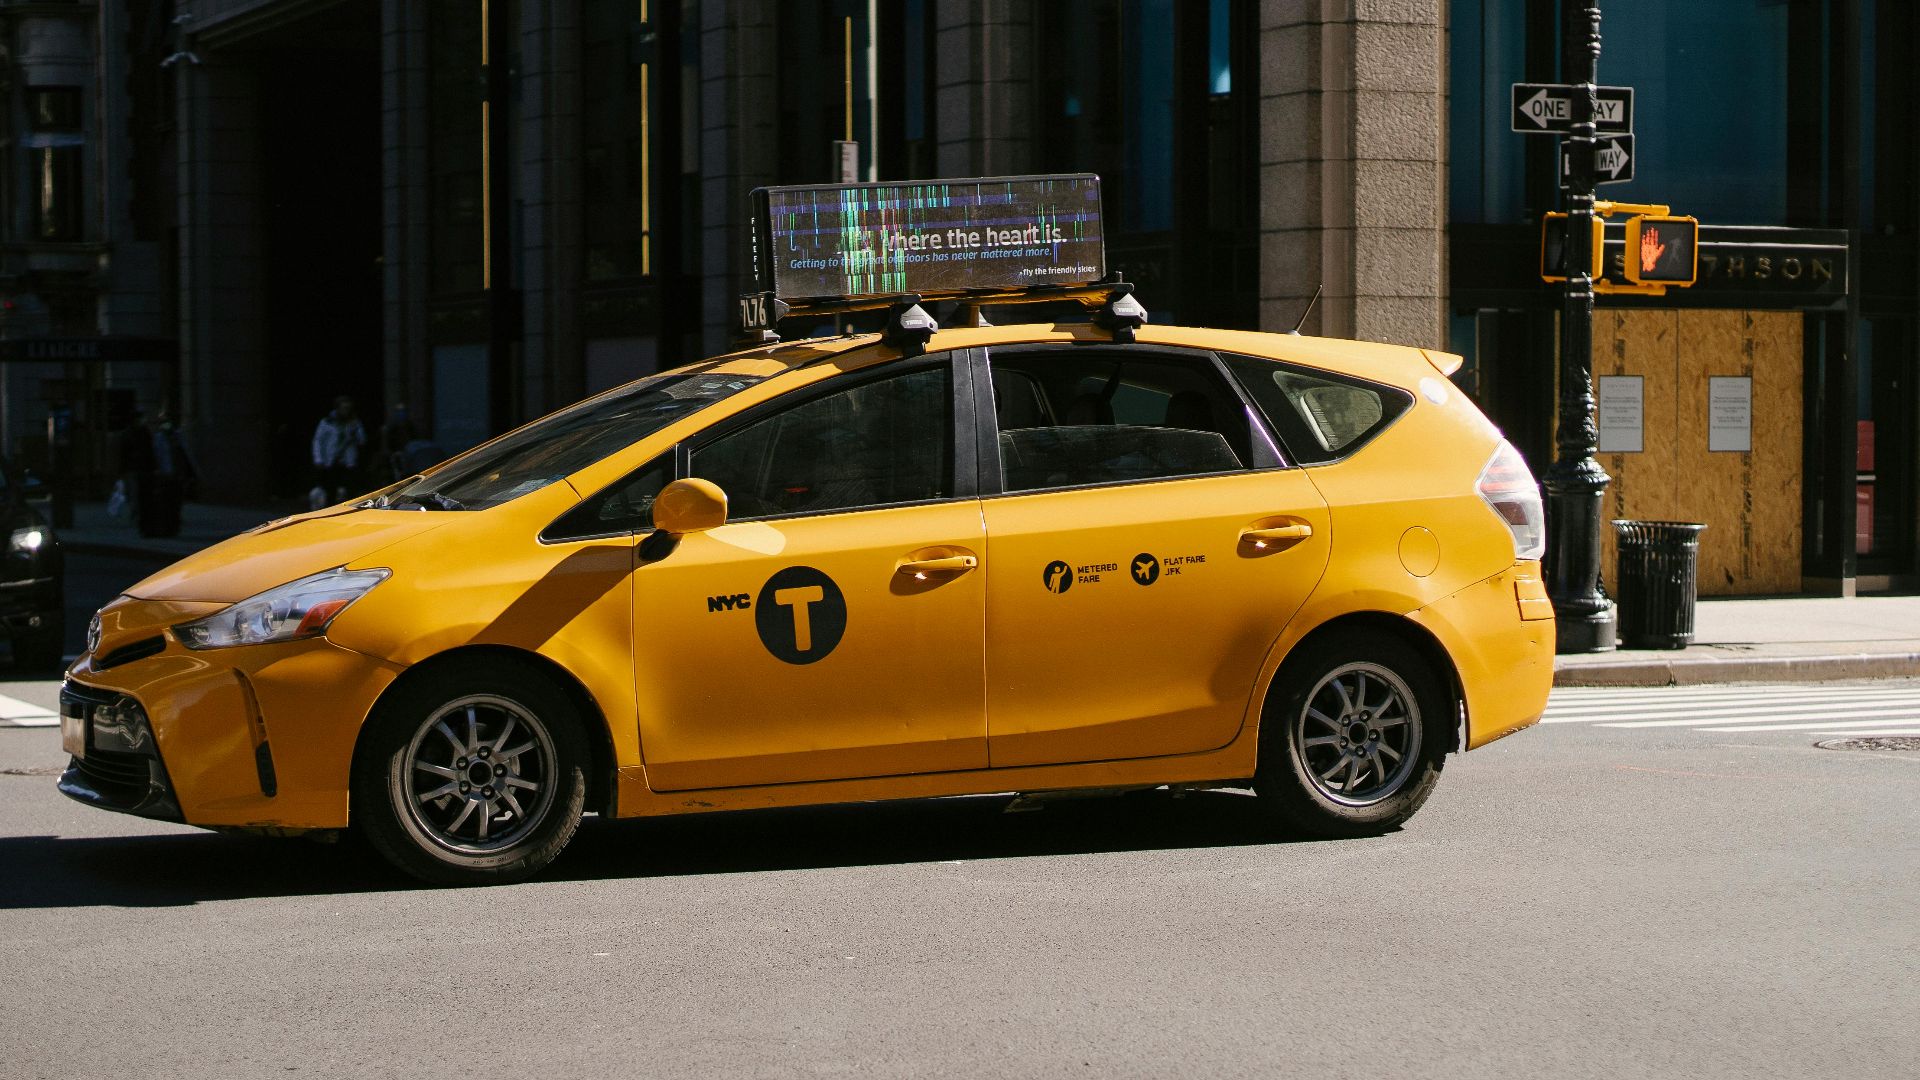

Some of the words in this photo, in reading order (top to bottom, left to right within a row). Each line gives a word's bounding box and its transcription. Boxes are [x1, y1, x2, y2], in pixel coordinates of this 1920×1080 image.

[1532, 100, 1565, 117] ONE
[1595, 102, 1616, 119] AY
[1600, 150, 1621, 168] WAY
[946, 228, 981, 248] the
[986, 224, 1041, 248] heart
[1046, 223, 1068, 244] is.
[751, 217, 759, 281] FIREFLY
[790, 257, 826, 270] Getting
[828, 257, 838, 267] to
[932, 251, 949, 262] has
[951, 251, 977, 260] never
[980, 248, 1023, 259] mattered
[1025, 248, 1052, 257] more.
[1615, 253, 1833, 280] STHSON
[1035, 267, 1047, 275] the
[1049, 266, 1077, 275] friendly
[1078, 265, 1096, 273] skies
[1077, 563, 1118, 574] METERED
[1163, 557, 1184, 566] FLAT
[1186, 555, 1206, 563] FARE
[1078, 574, 1100, 584] FARE
[1165, 567, 1181, 576] JFK
[707, 593, 751, 612] NYC
[774, 585, 824, 651] T
